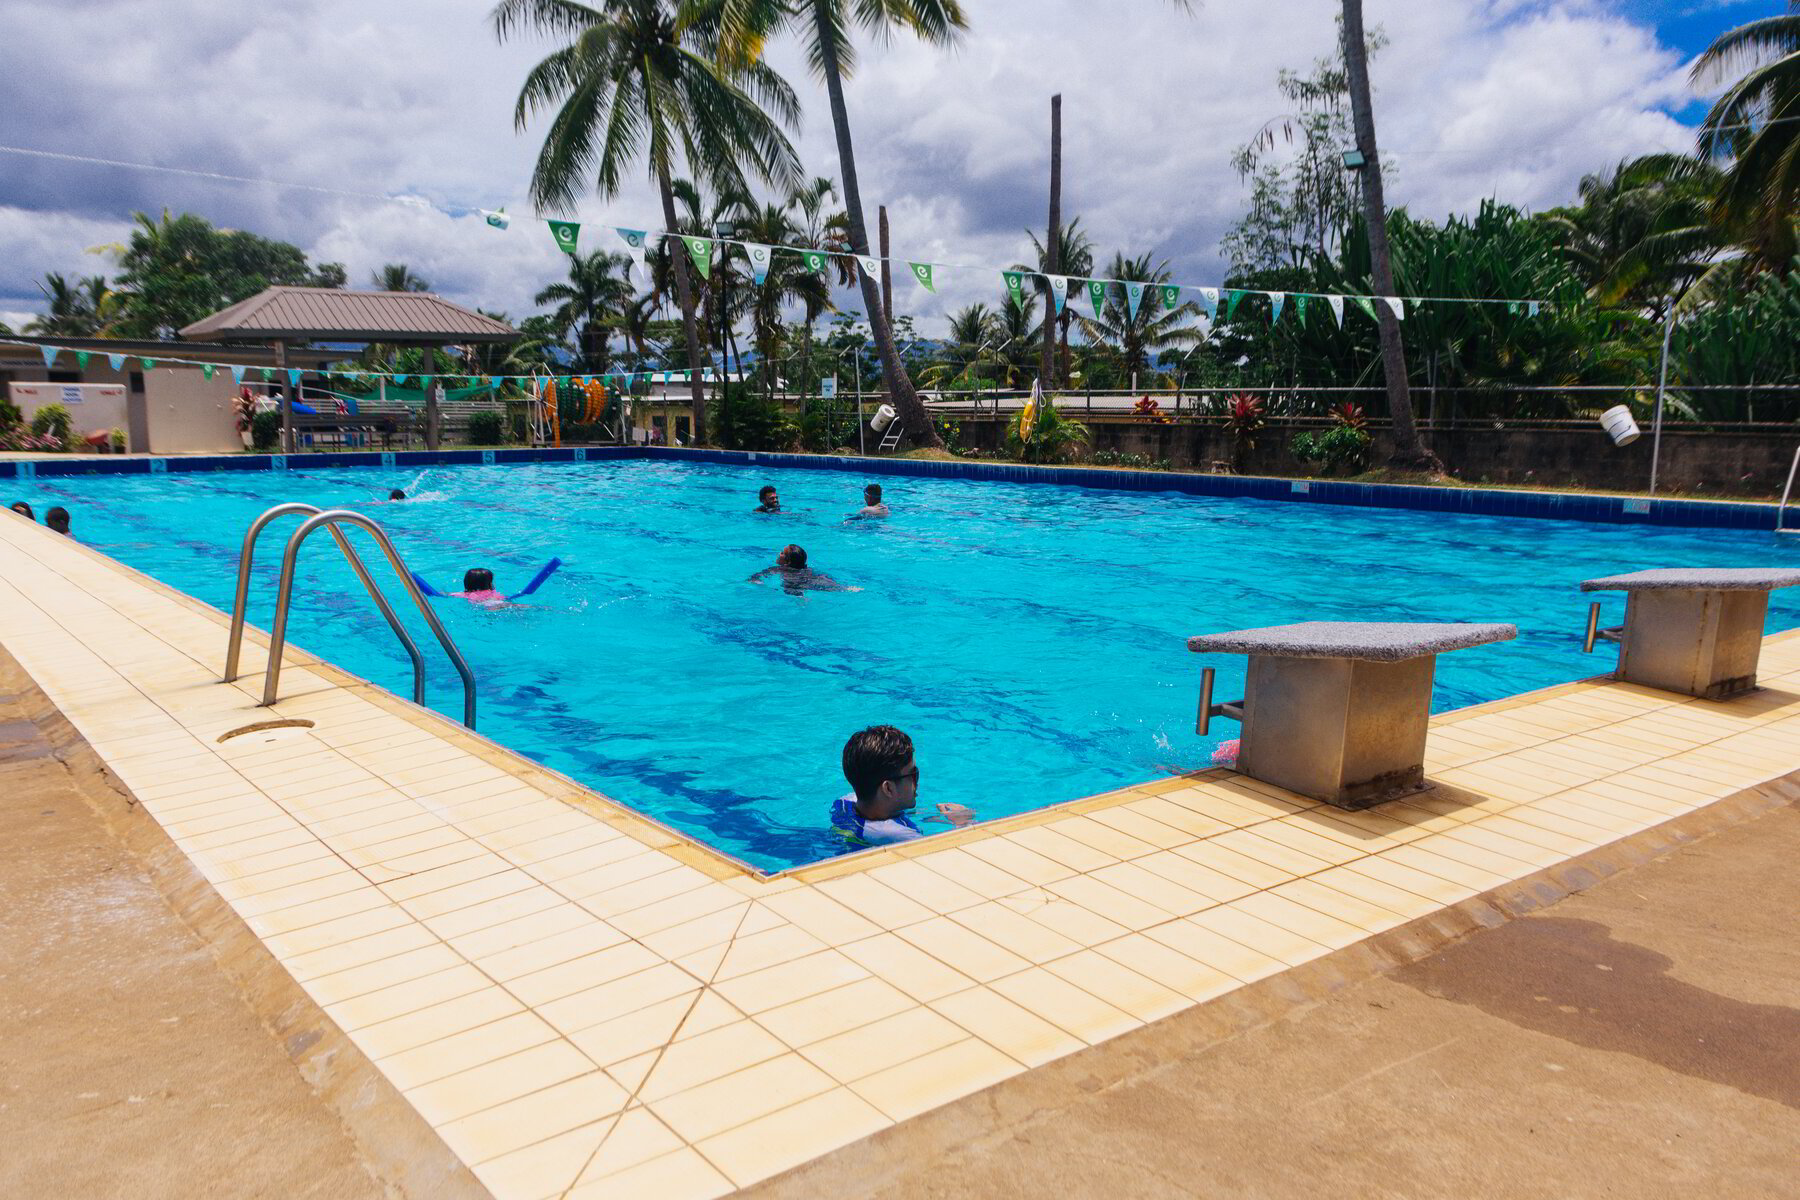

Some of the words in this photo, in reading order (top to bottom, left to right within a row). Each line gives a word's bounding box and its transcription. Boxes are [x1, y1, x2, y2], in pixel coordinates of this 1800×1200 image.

[384, 453, 393, 465] 4
[484, 451, 492, 463] 5
[577, 449, 584, 460] 6
[154, 459, 164, 471] 2
[275, 457, 284, 469] 3
